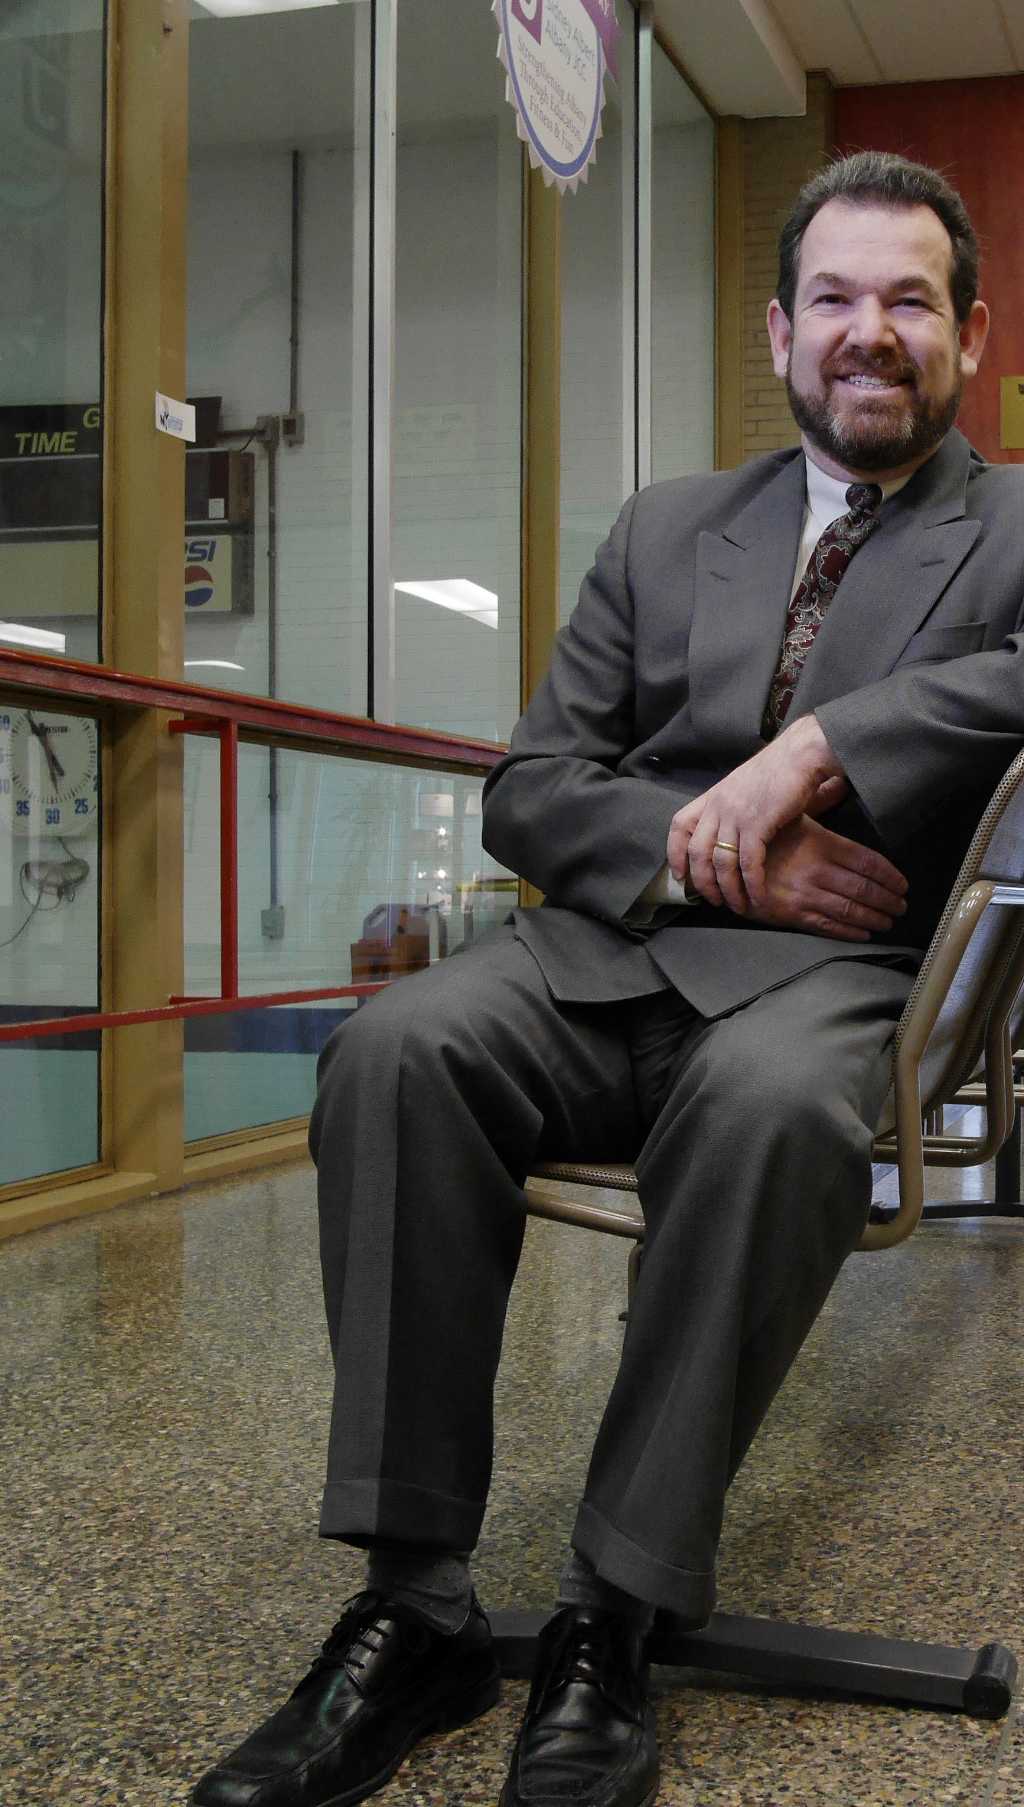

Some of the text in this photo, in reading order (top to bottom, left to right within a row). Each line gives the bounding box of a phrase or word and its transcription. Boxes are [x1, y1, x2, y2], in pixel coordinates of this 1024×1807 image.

[15, 431, 78, 455] TIME
[16, 800, 30, 817] 35
[74, 798, 89, 815] 25
[45, 807, 60, 825] 30
